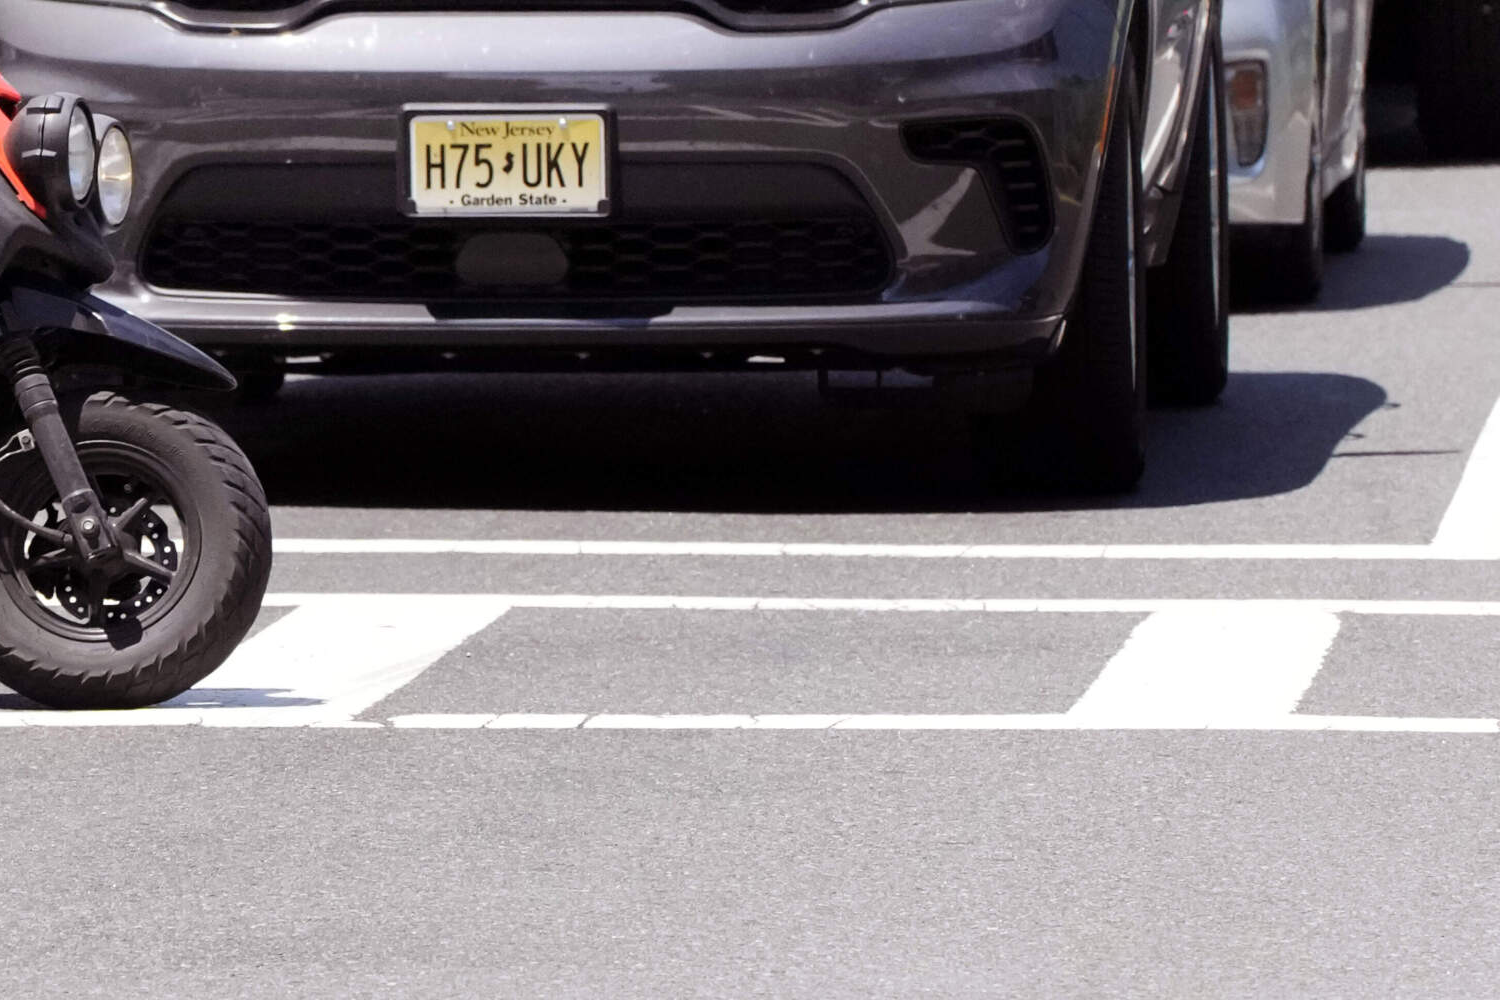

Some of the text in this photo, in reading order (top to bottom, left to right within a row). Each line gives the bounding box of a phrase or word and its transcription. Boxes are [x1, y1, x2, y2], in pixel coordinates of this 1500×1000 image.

[460, 122, 556, 139] New Jersey
[425, 142, 589, 189] H75 UKY
[461, 193, 557, 207] Garden State
